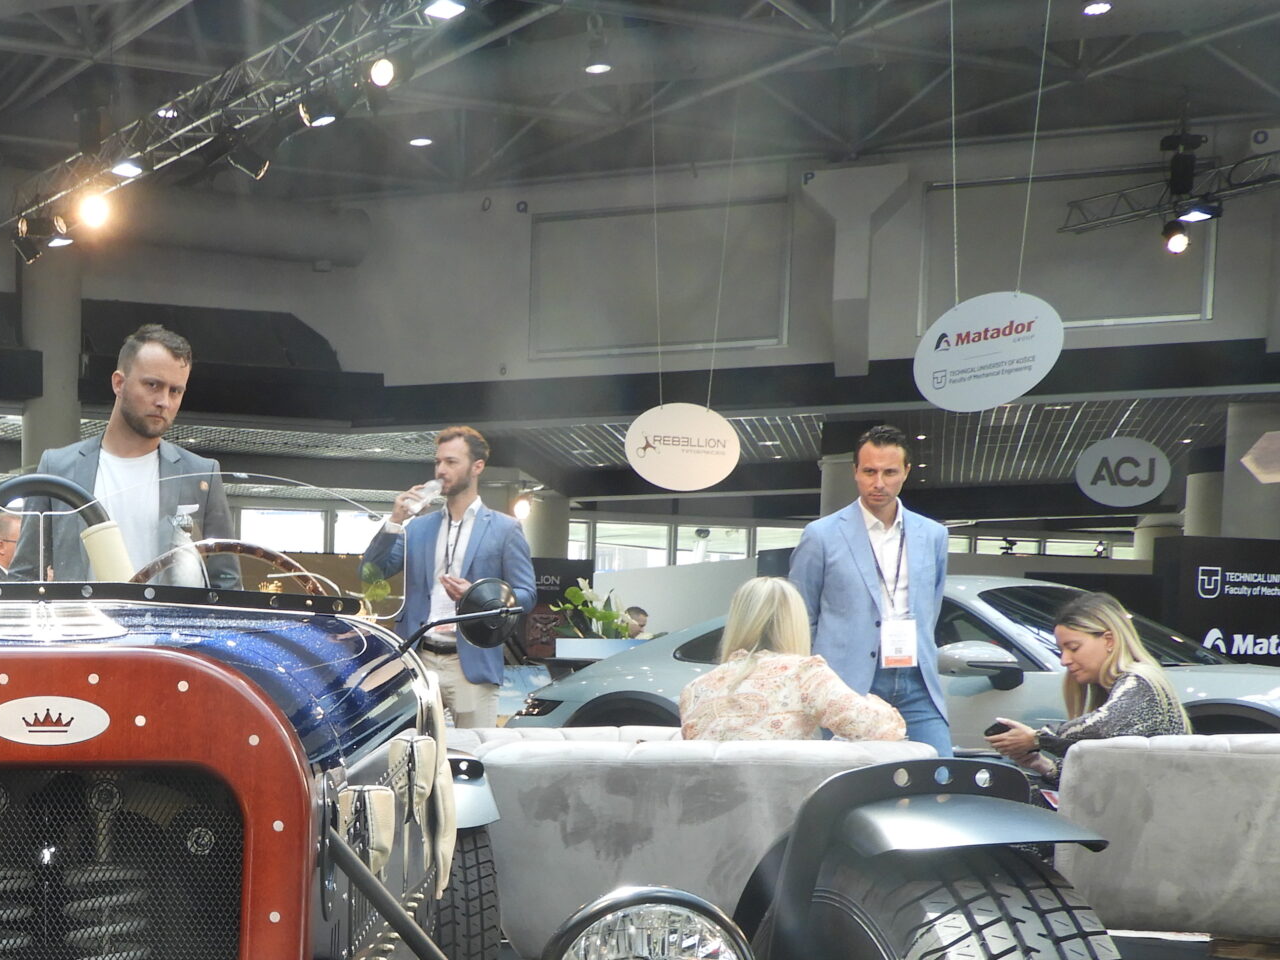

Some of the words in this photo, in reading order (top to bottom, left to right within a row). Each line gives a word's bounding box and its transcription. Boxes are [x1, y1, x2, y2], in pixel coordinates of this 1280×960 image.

[803, 171, 815, 186] P
[955, 320, 1035, 346] Matador
[653, 435, 726, 448] REBELLION
[1090, 456, 1156, 487] ACJ
[1225, 572, 1265, 583] TECHNICAL
[1224, 585, 1251, 596] Faculty
[1252, 585, 1260, 595] of
[1231, 634, 1280, 655] Mat
